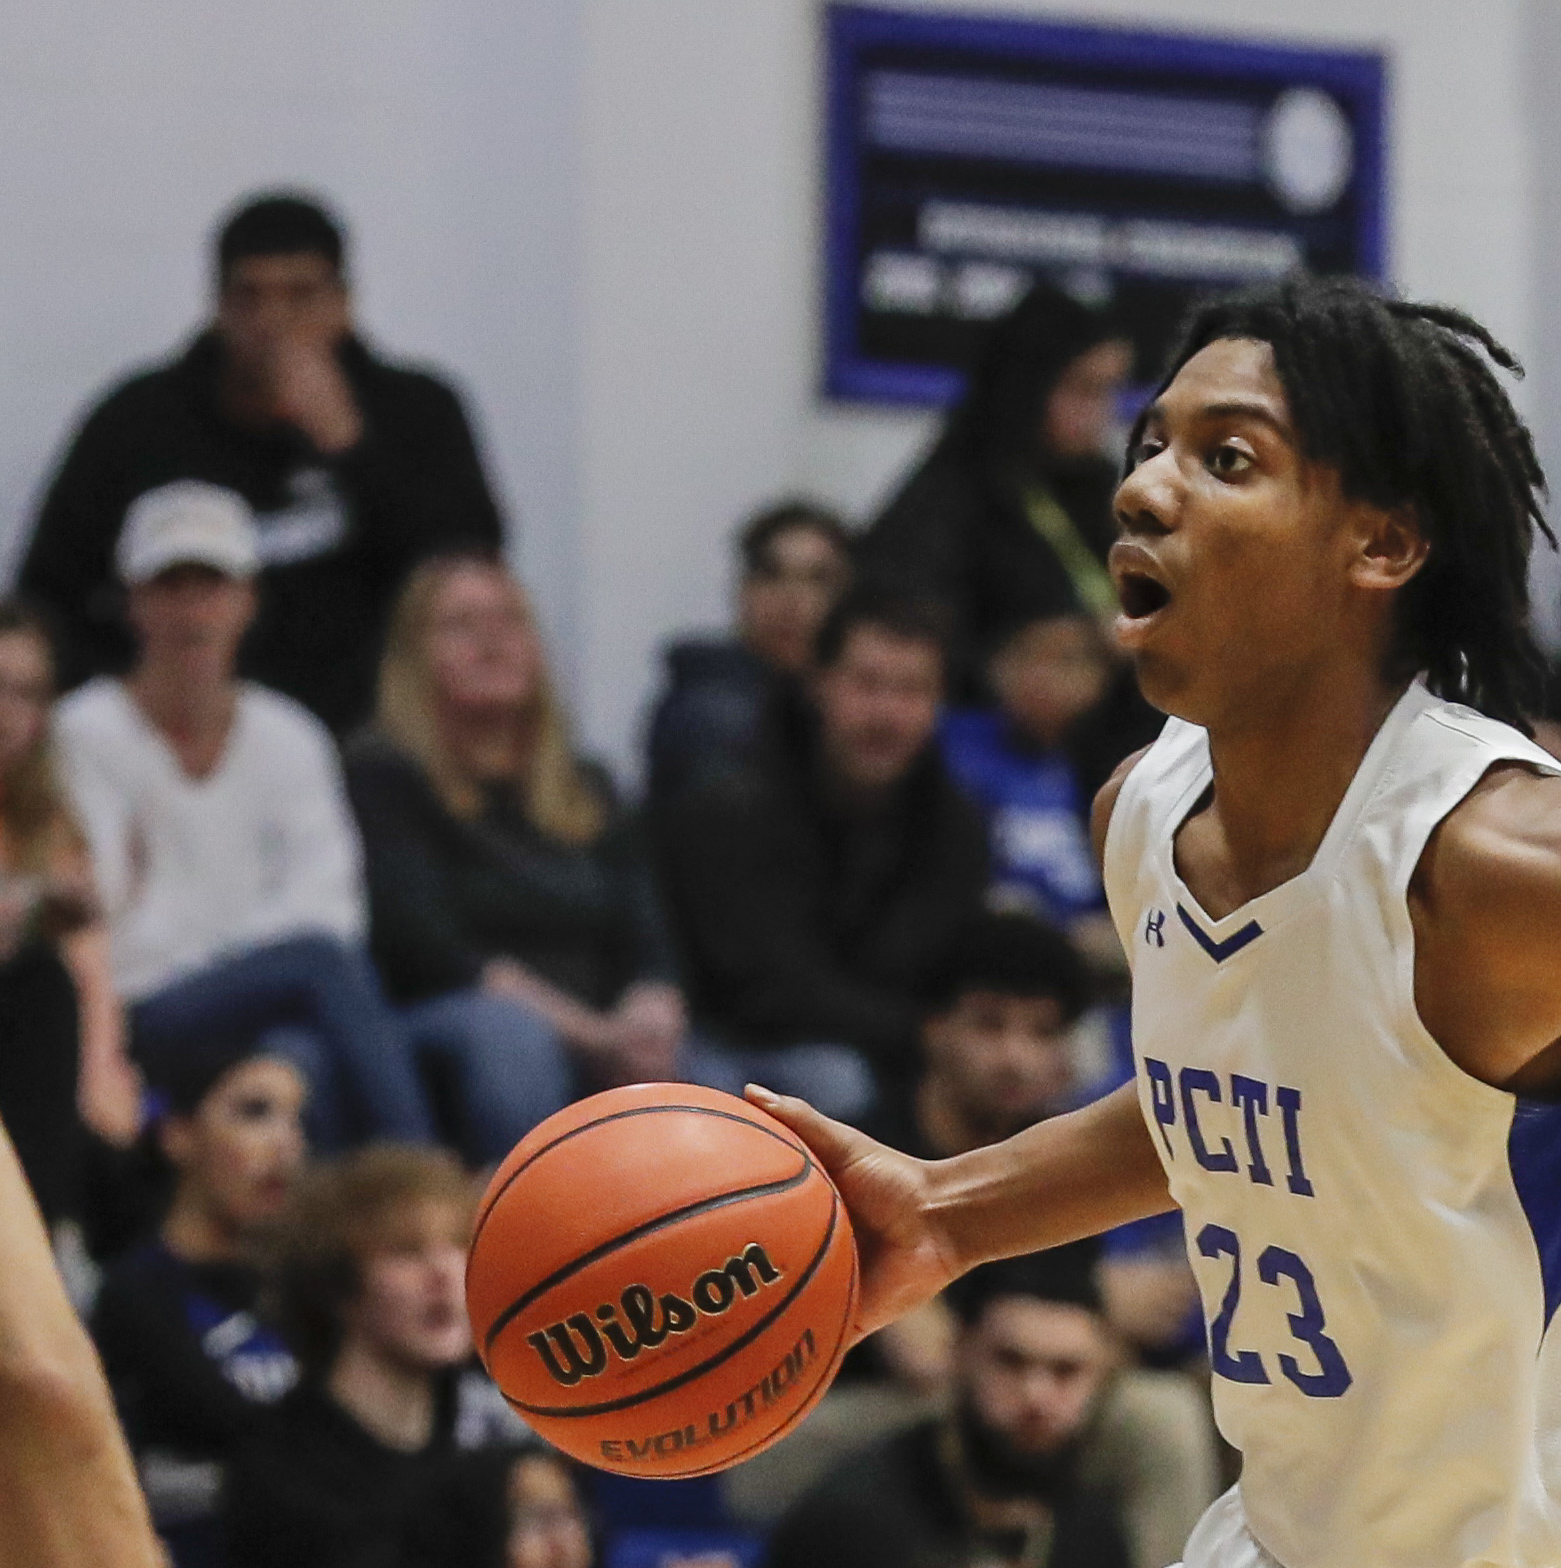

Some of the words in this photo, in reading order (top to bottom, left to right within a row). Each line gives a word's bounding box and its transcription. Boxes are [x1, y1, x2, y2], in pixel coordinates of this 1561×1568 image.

[1143, 1056, 1315, 1198] PCTI
[526, 1242, 784, 1387] Wilson
[1196, 1223, 1353, 1397] 23
[599, 1327, 818, 1463] EVOLUTION
